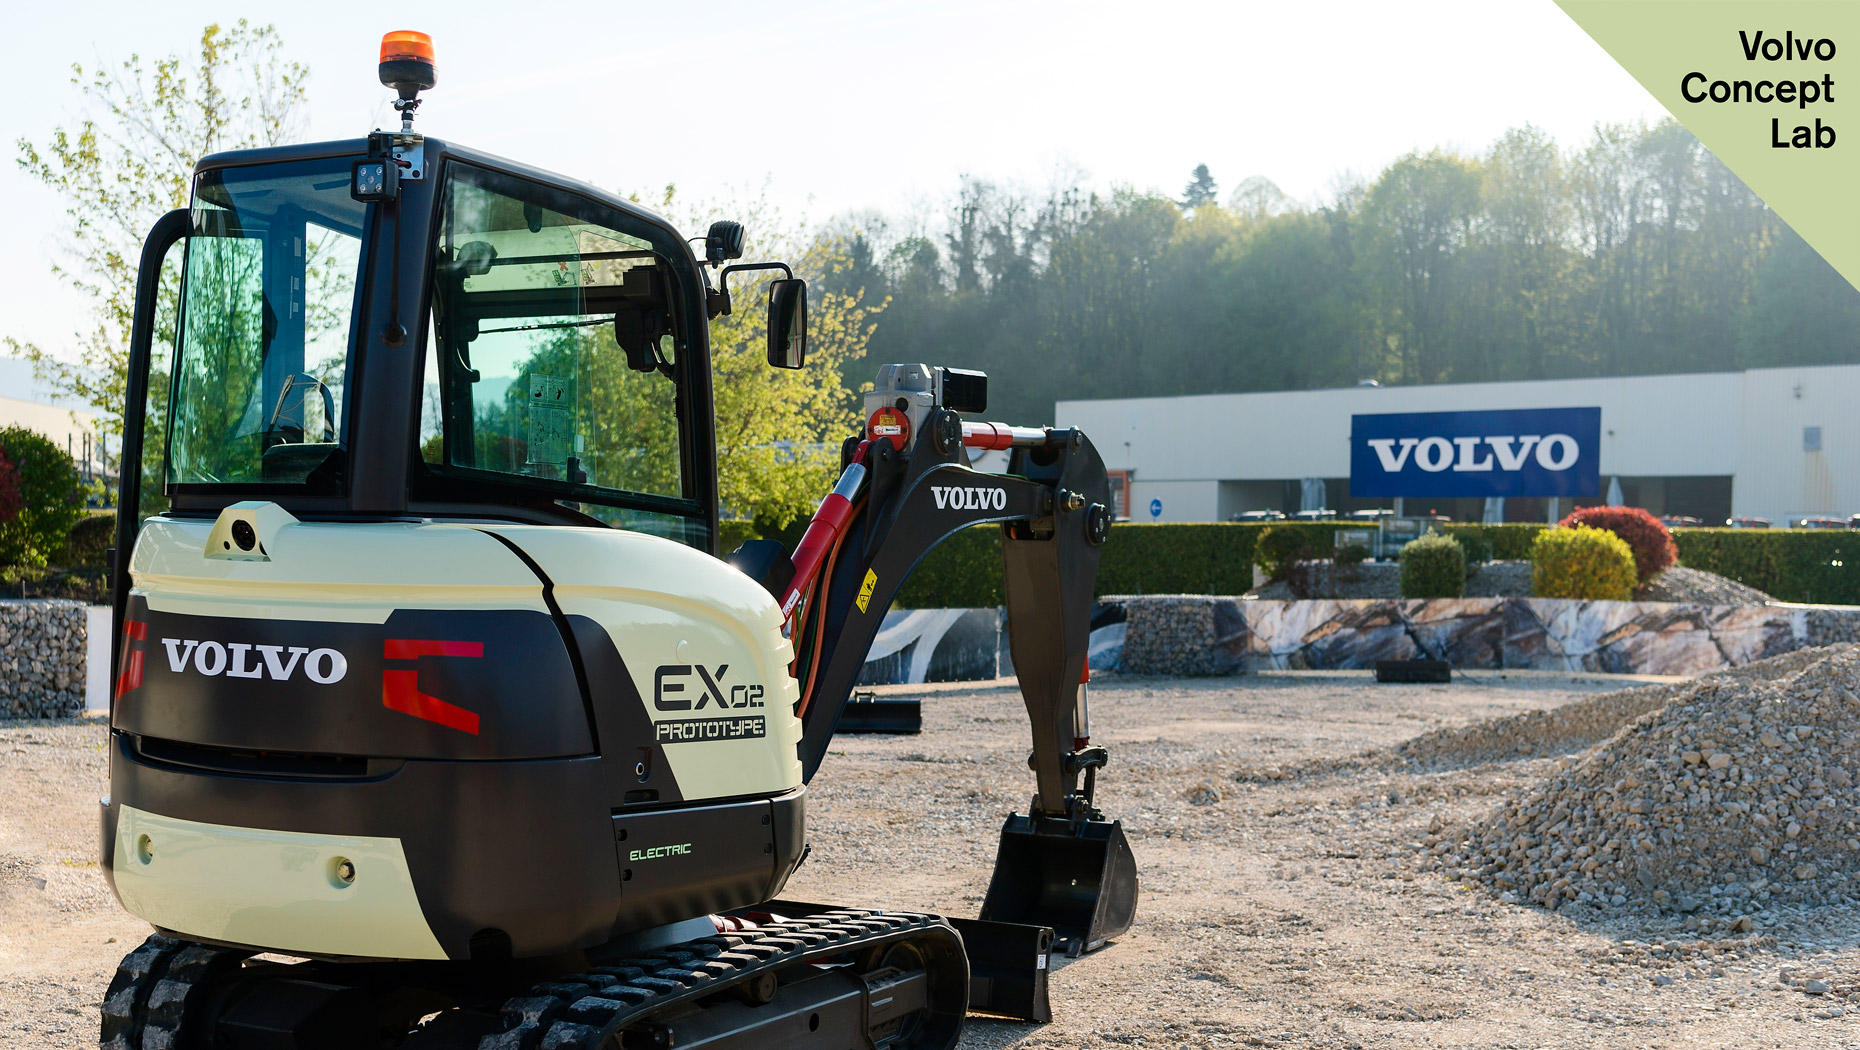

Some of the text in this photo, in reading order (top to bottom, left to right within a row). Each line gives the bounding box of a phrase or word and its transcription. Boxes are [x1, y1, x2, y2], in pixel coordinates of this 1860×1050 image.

[1367, 434, 1580, 472] VOLVO
[931, 487, 1007, 510] VOLVO
[161, 638, 348, 685] VOLVO
[656, 719, 764, 741] PROTOTYPE
[629, 843, 692, 861] ELECTRIC
